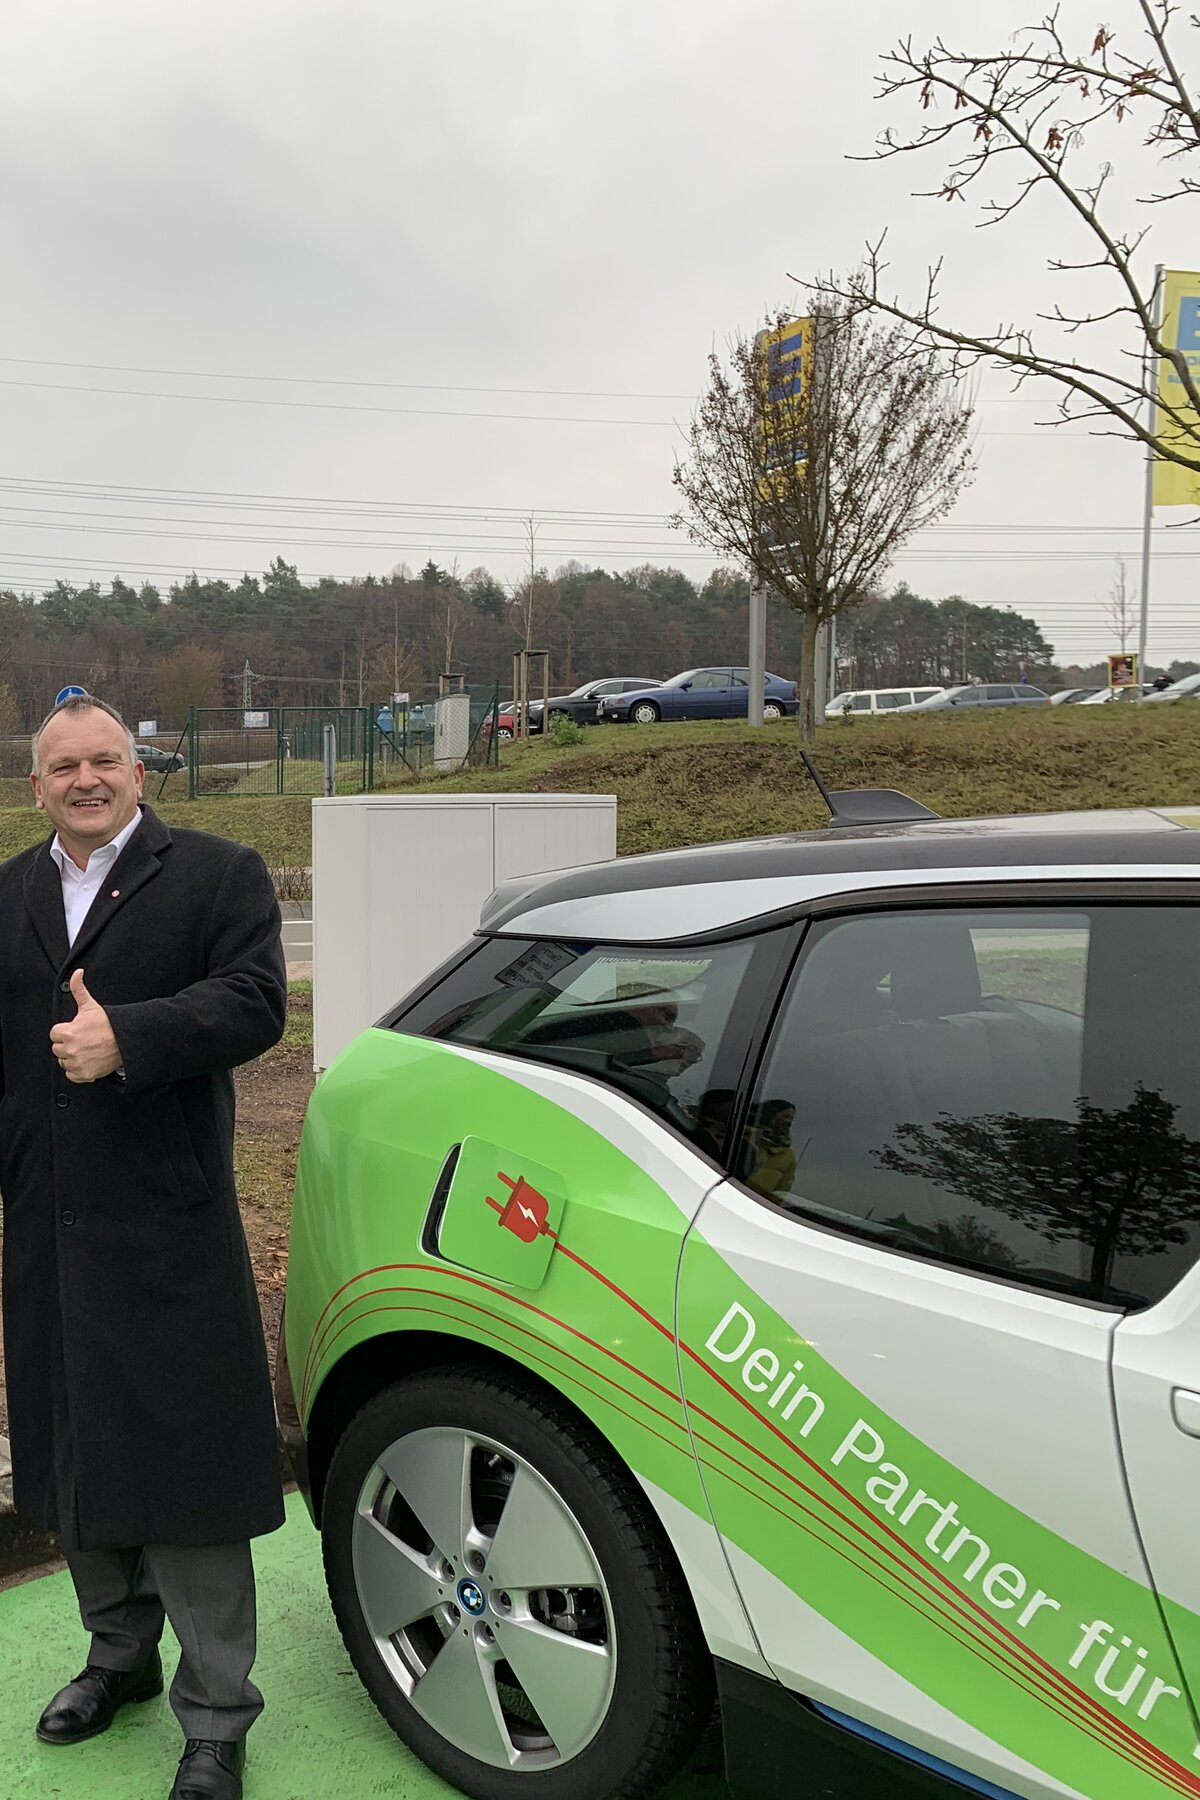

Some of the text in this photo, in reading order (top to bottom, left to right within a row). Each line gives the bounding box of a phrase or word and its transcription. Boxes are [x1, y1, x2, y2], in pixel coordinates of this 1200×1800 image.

[704, 1300, 1181, 1721] Dein Partner für
